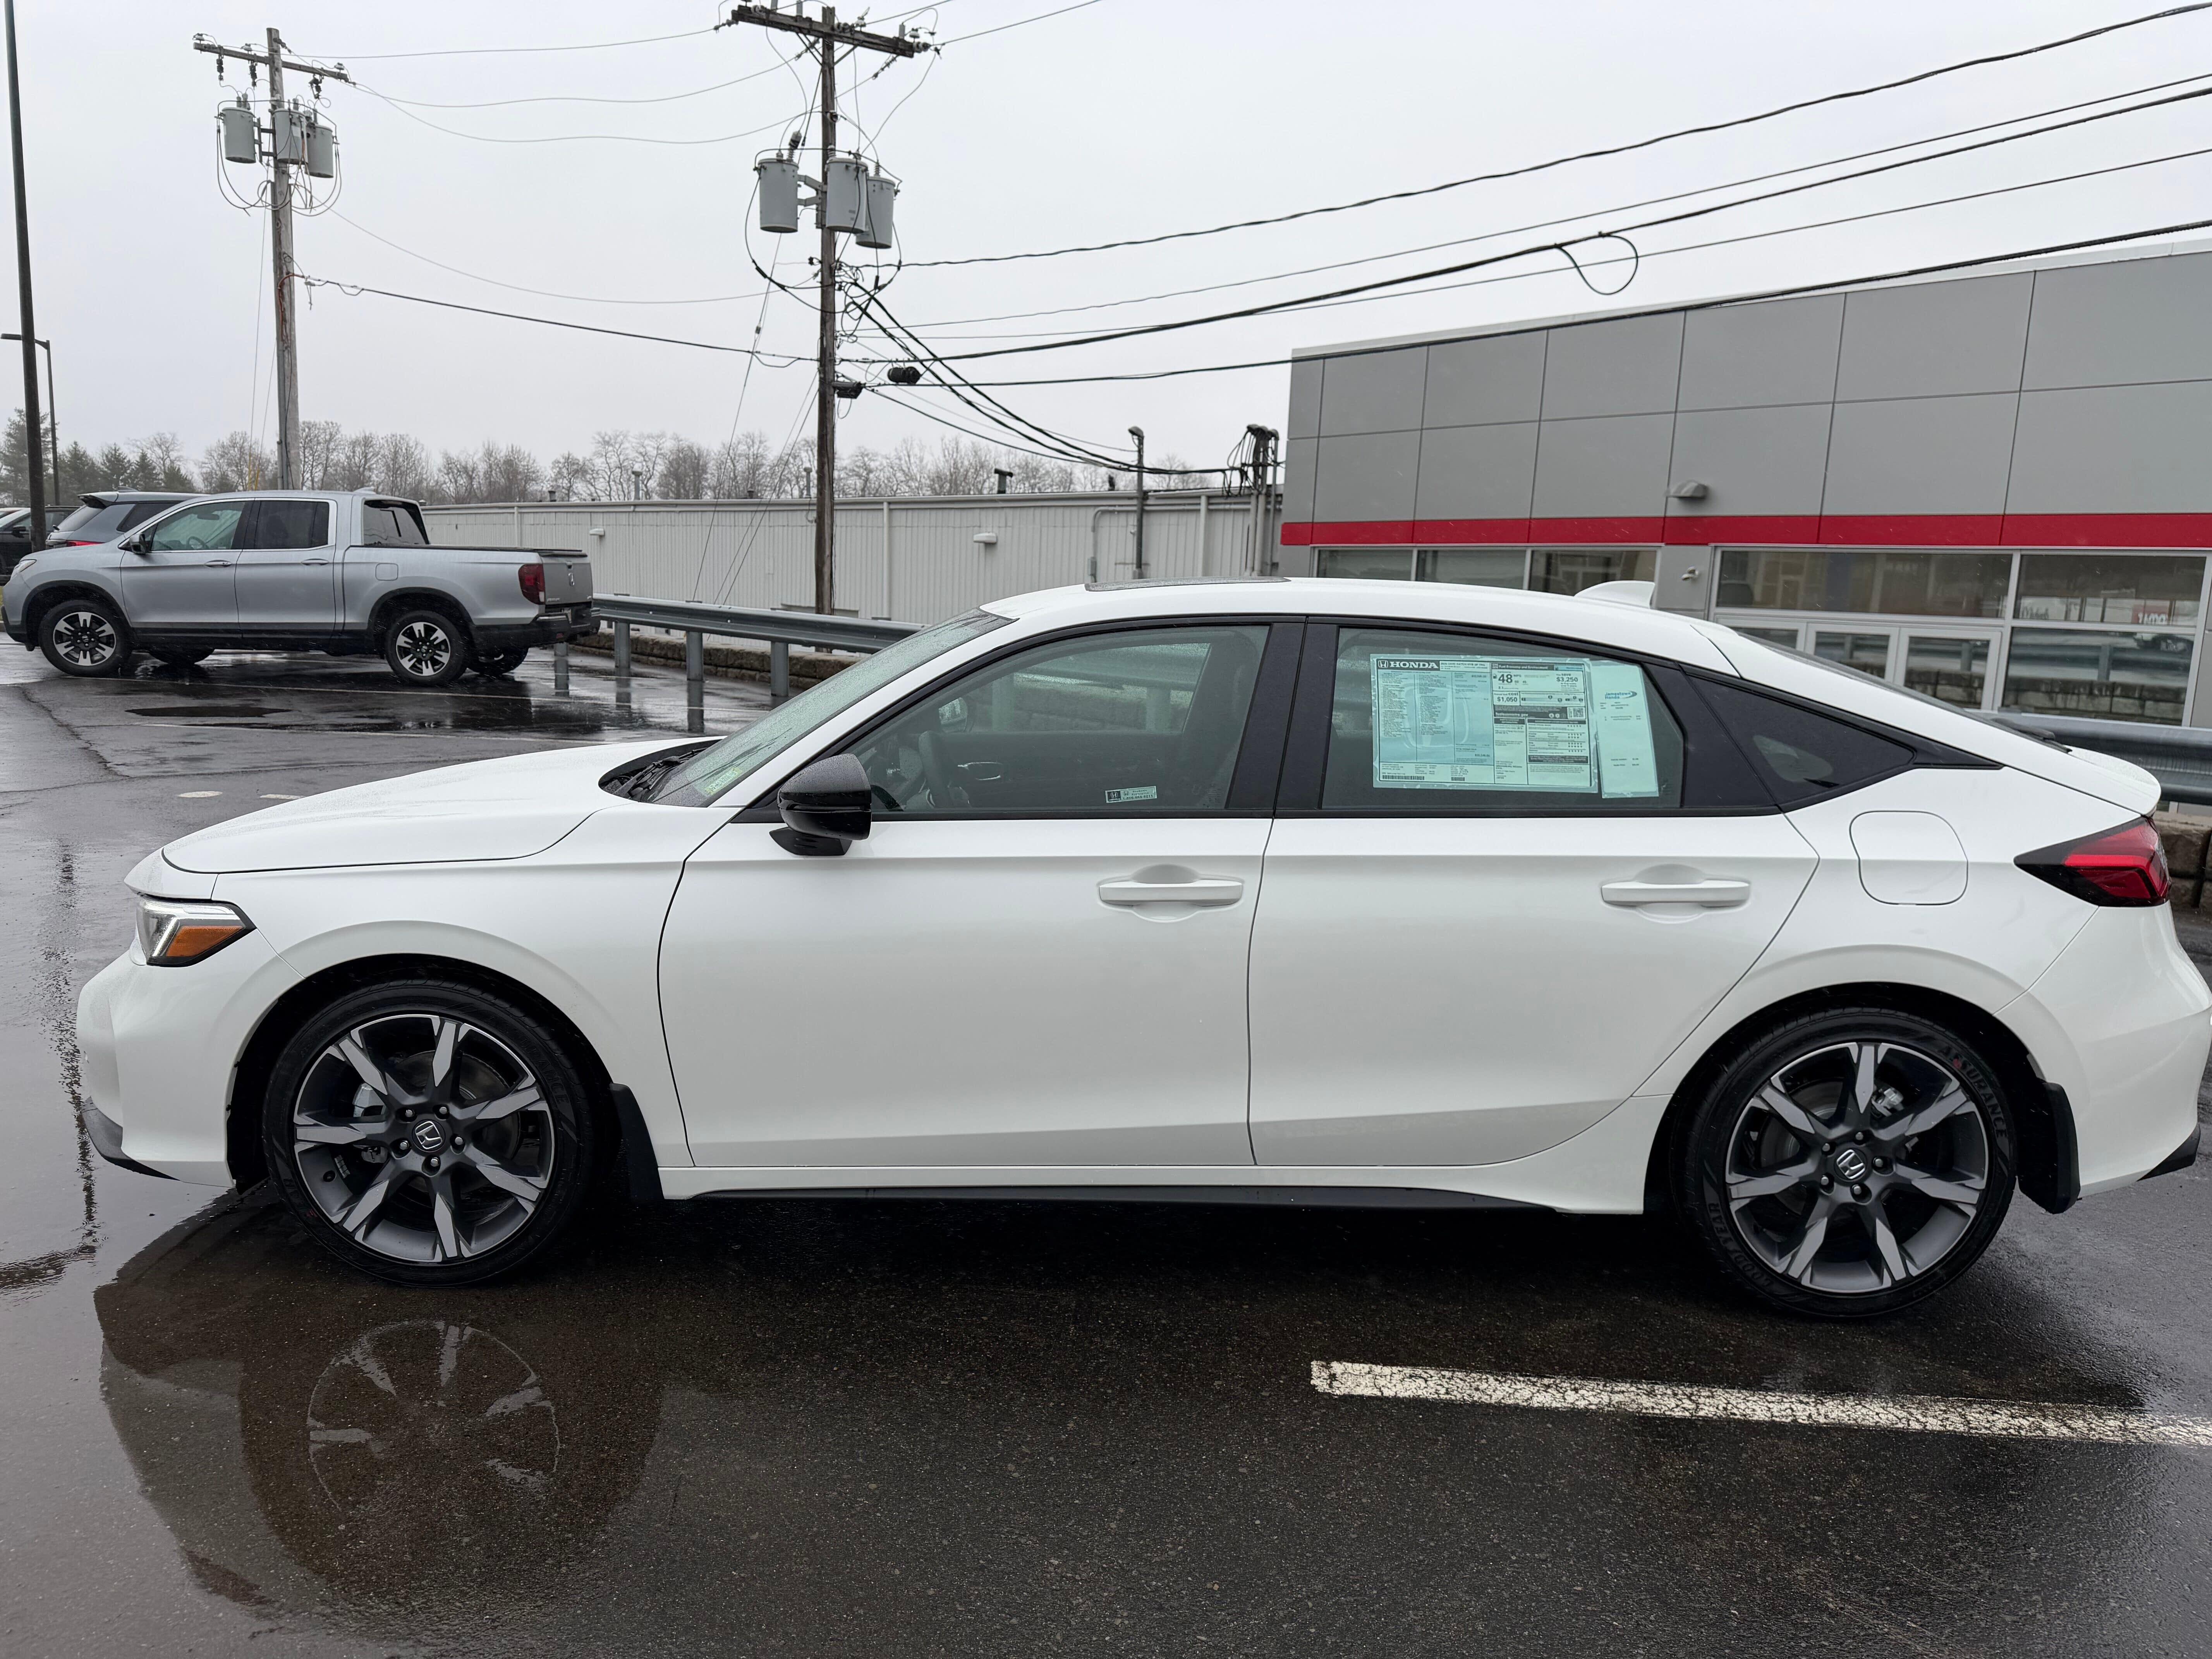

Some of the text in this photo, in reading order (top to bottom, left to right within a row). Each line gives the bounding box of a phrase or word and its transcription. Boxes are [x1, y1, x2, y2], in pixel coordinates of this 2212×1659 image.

[1498, 674, 1513, 683] 48
[1938, 1047, 2008, 1137] ASSURANCE
[1708, 1203, 1773, 1286] GOODYEAR
